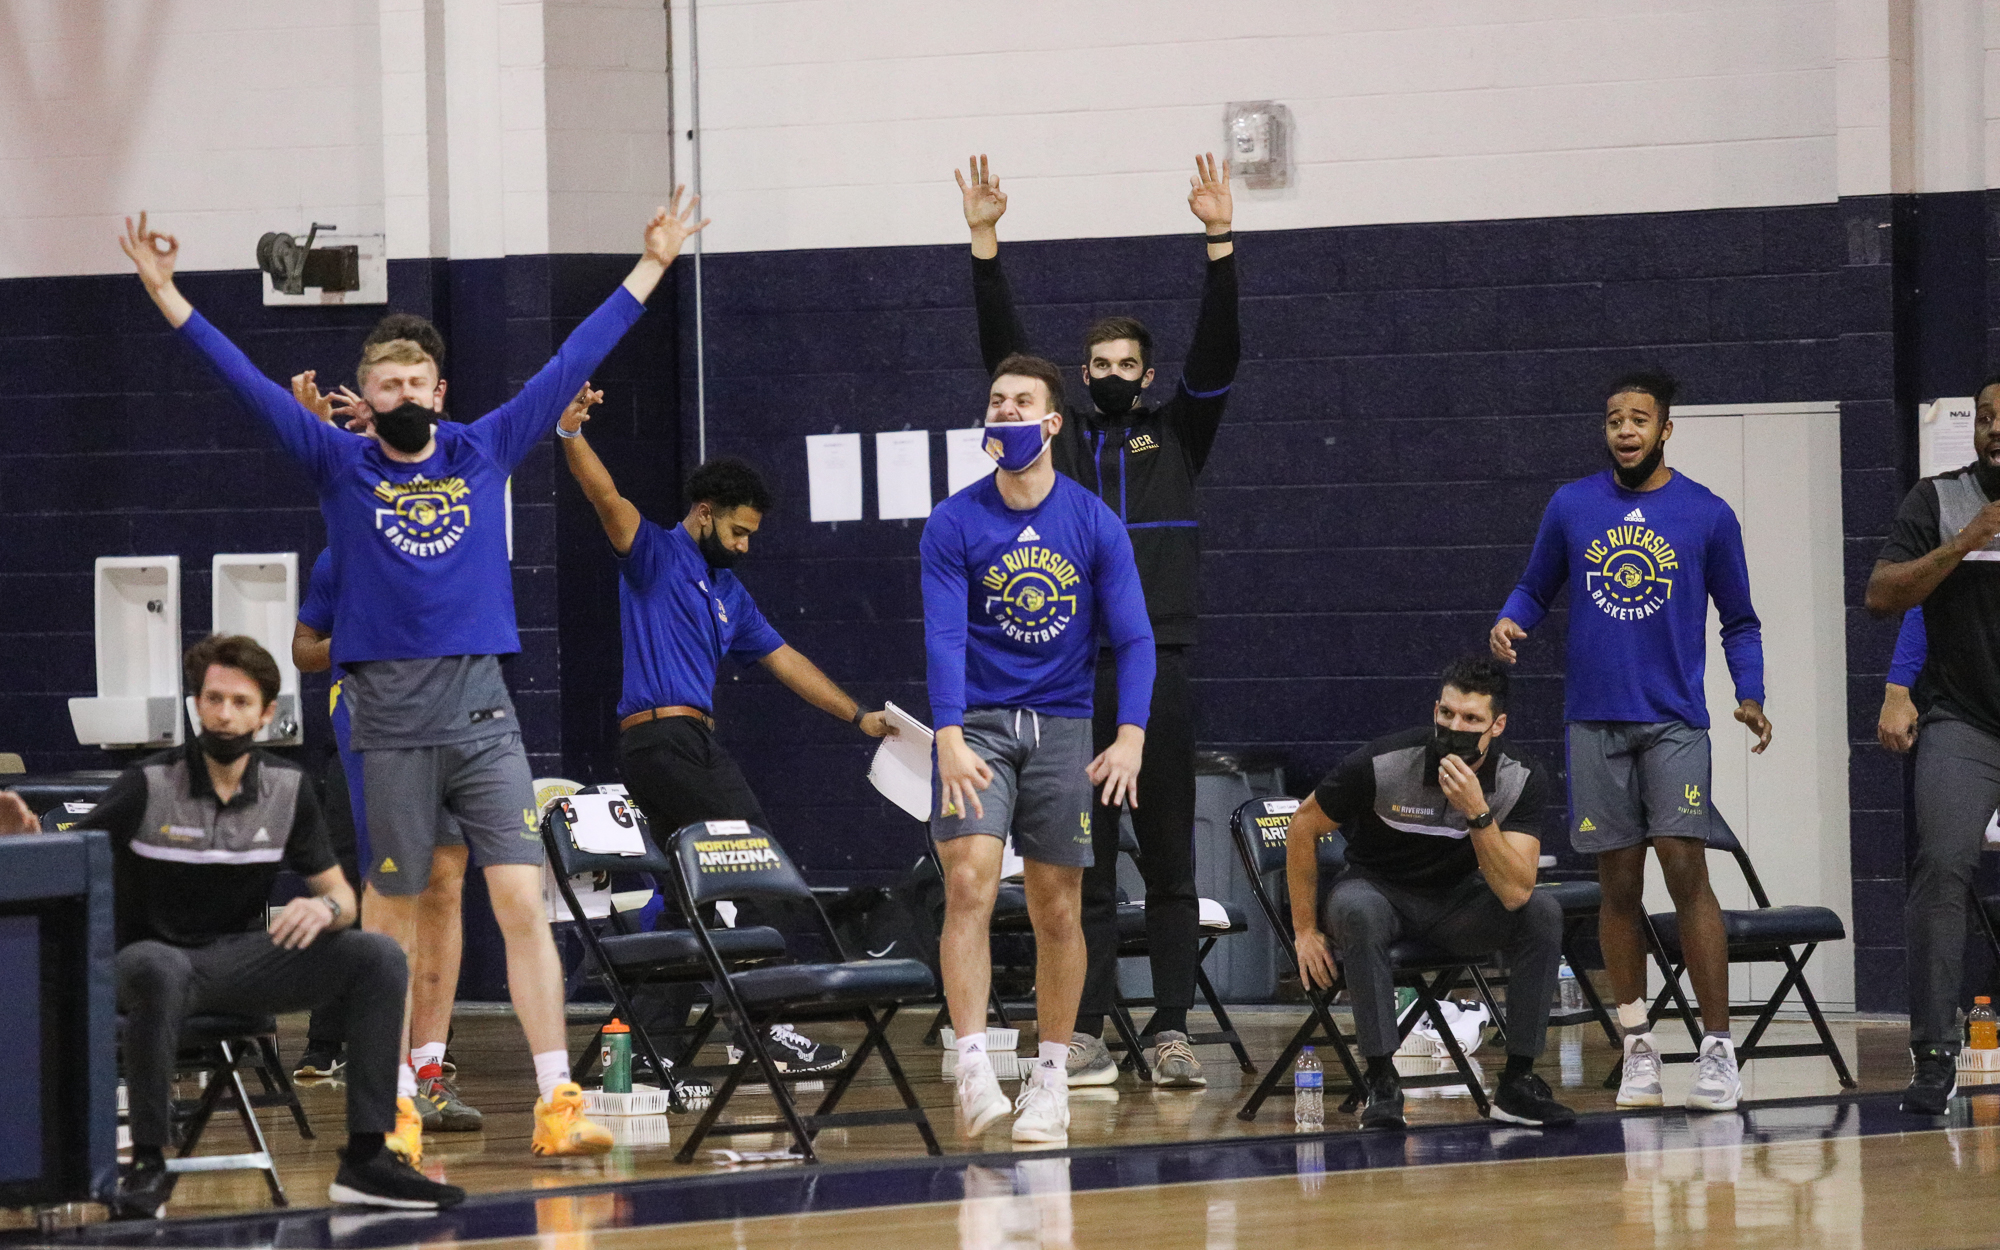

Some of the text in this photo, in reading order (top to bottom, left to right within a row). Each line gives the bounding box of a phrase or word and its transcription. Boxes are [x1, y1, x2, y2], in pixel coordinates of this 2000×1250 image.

[1129, 434, 1154, 449] UCR
[384, 525, 465, 557] BASKETBALL
[1584, 525, 1679, 572] UC RIVERSIDE
[982, 546, 1080, 591] UC RIVERSIDE
[1591, 589, 1665, 621] BASKETBALL
[995, 613, 1070, 644] BASKETBALL
[1685, 783, 1701, 807] UC
[1401, 805, 1435, 816] RIVERSIDE
[1080, 811, 1091, 835] UC
[693, 838, 770, 852] NORTHERN
[699, 848, 780, 866] ARIZONA
[701, 862, 781, 873] UNIVERSITY
